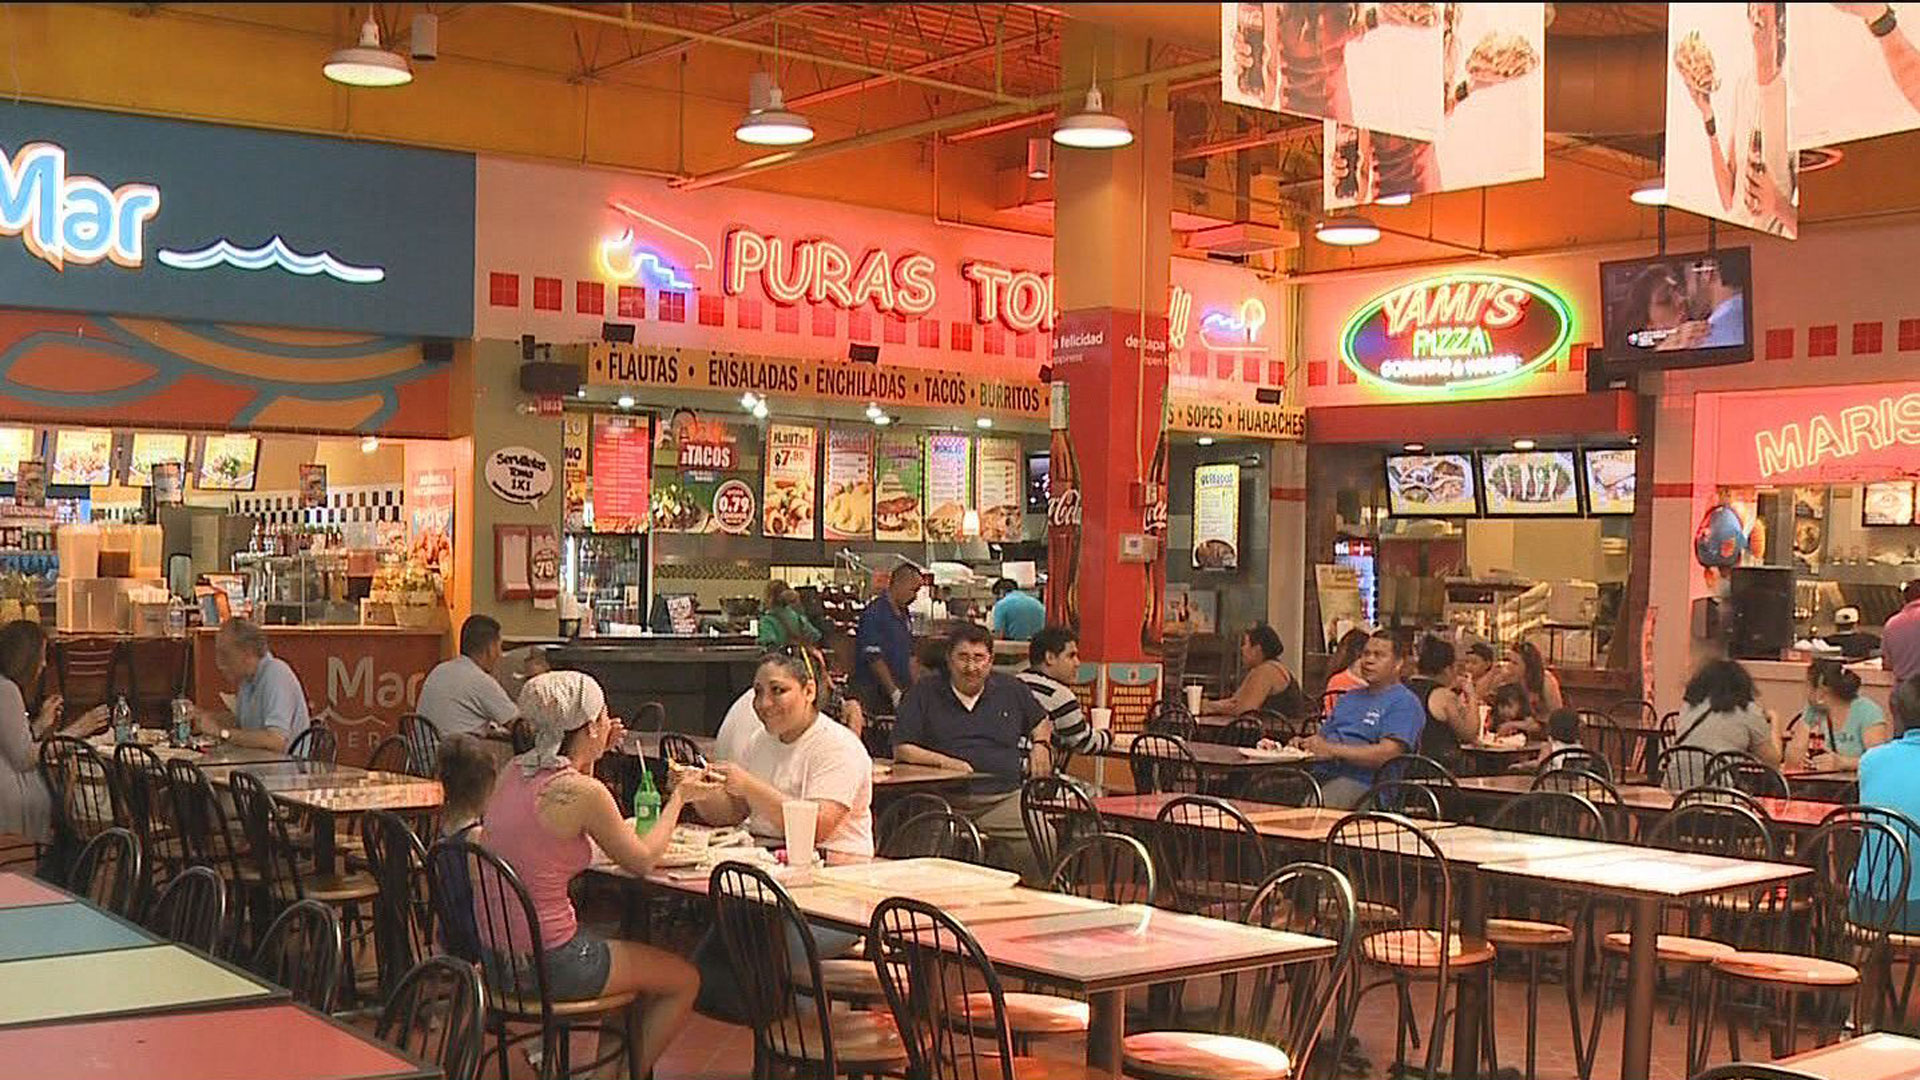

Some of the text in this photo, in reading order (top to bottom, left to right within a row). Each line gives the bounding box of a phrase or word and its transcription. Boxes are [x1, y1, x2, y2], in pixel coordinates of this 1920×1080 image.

[0, 141, 160, 270] Mar
[727, 227, 936, 316] PURAS
[1382, 283, 1530, 337] YAMI'S
[1060, 332, 1103, 349] felicidad
[1412, 325, 1494, 357] PIZZA
[608, 351, 1039, 412] FLAUTAS ENSALADAS ENCHILADAS TACOS BURRITOS
[1186, 404, 1223, 429] SOPES
[1238, 409, 1305, 436] HUARACHES
[1755, 393, 1920, 478] MARIS
[327, 655, 427, 709] Mar
